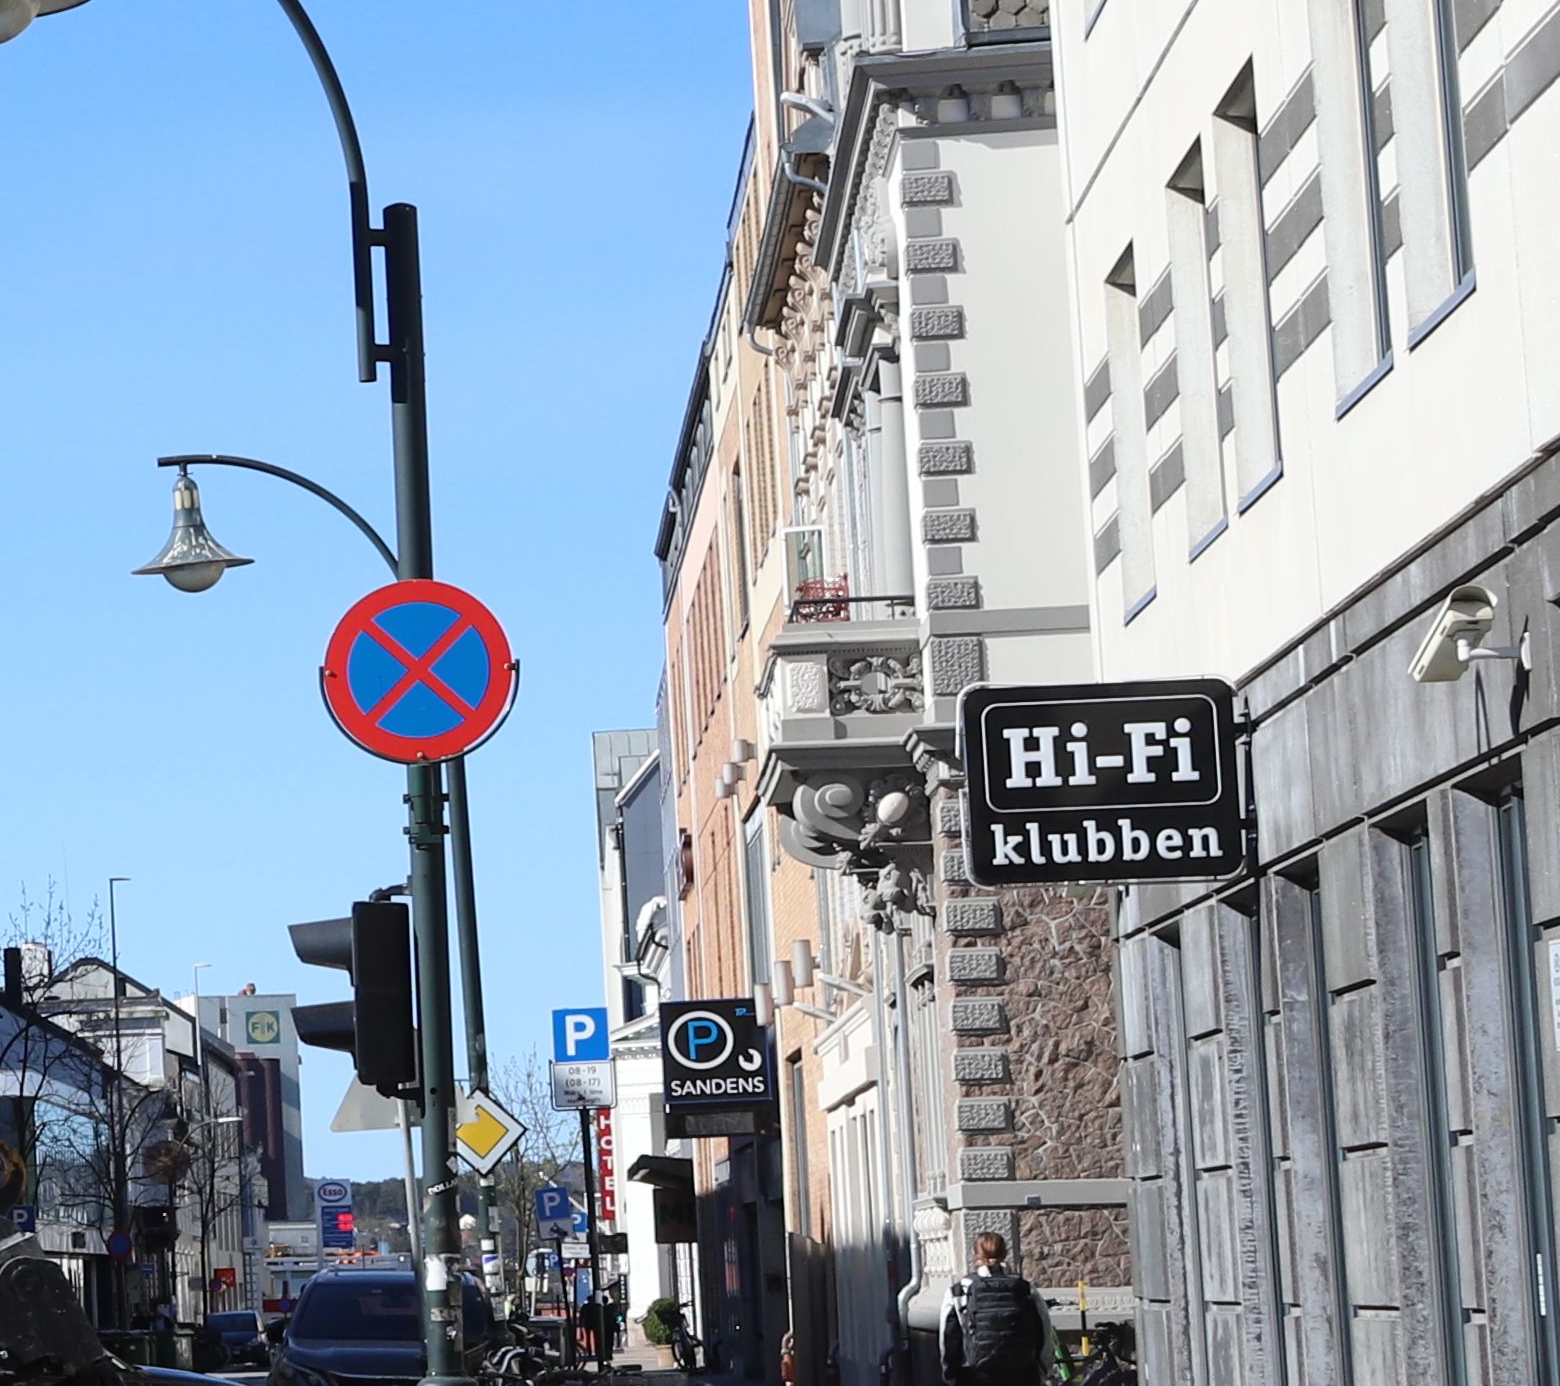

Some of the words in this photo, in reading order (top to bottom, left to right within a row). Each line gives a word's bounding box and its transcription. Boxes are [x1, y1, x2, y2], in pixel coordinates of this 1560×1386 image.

[1003, 717, 1200, 789] Hi-Fi
[990, 819, 1224, 866] klubben
[565, 1014, 596, 1056] P
[687, 1020, 718, 1060] P
[670, 1076, 765, 1096] SANDENS
[599, 1115, 615, 1210] HOTEL
[323, 1188, 344, 1197] Esso
[543, 1193, 561, 1217] P
